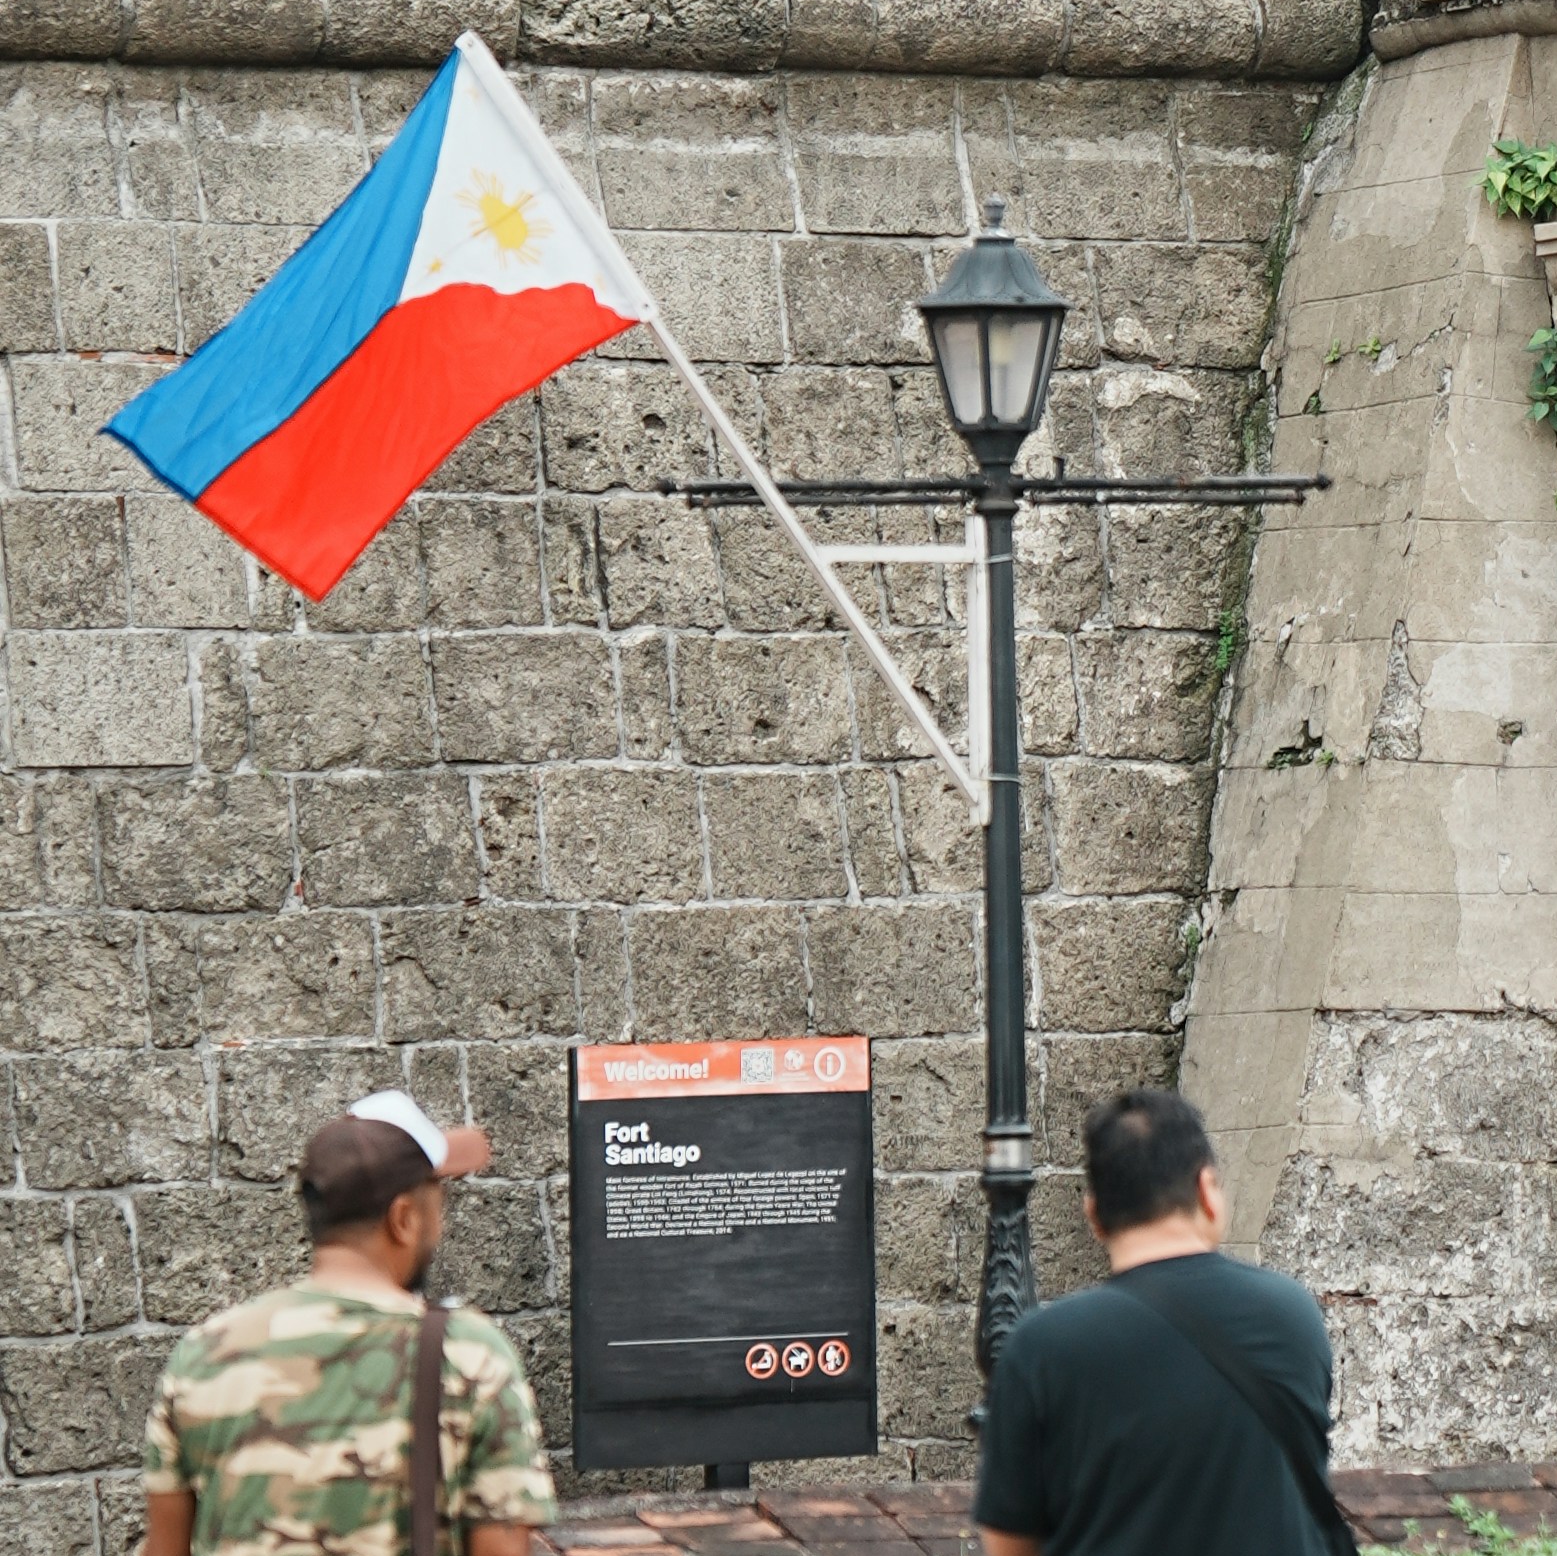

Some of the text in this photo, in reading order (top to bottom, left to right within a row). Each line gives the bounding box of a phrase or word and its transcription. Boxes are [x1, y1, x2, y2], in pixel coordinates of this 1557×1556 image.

[604, 1059, 709, 1082] Welcome!
[604, 1121, 650, 1144] Fort
[604, 1142, 701, 1167] Santiago
